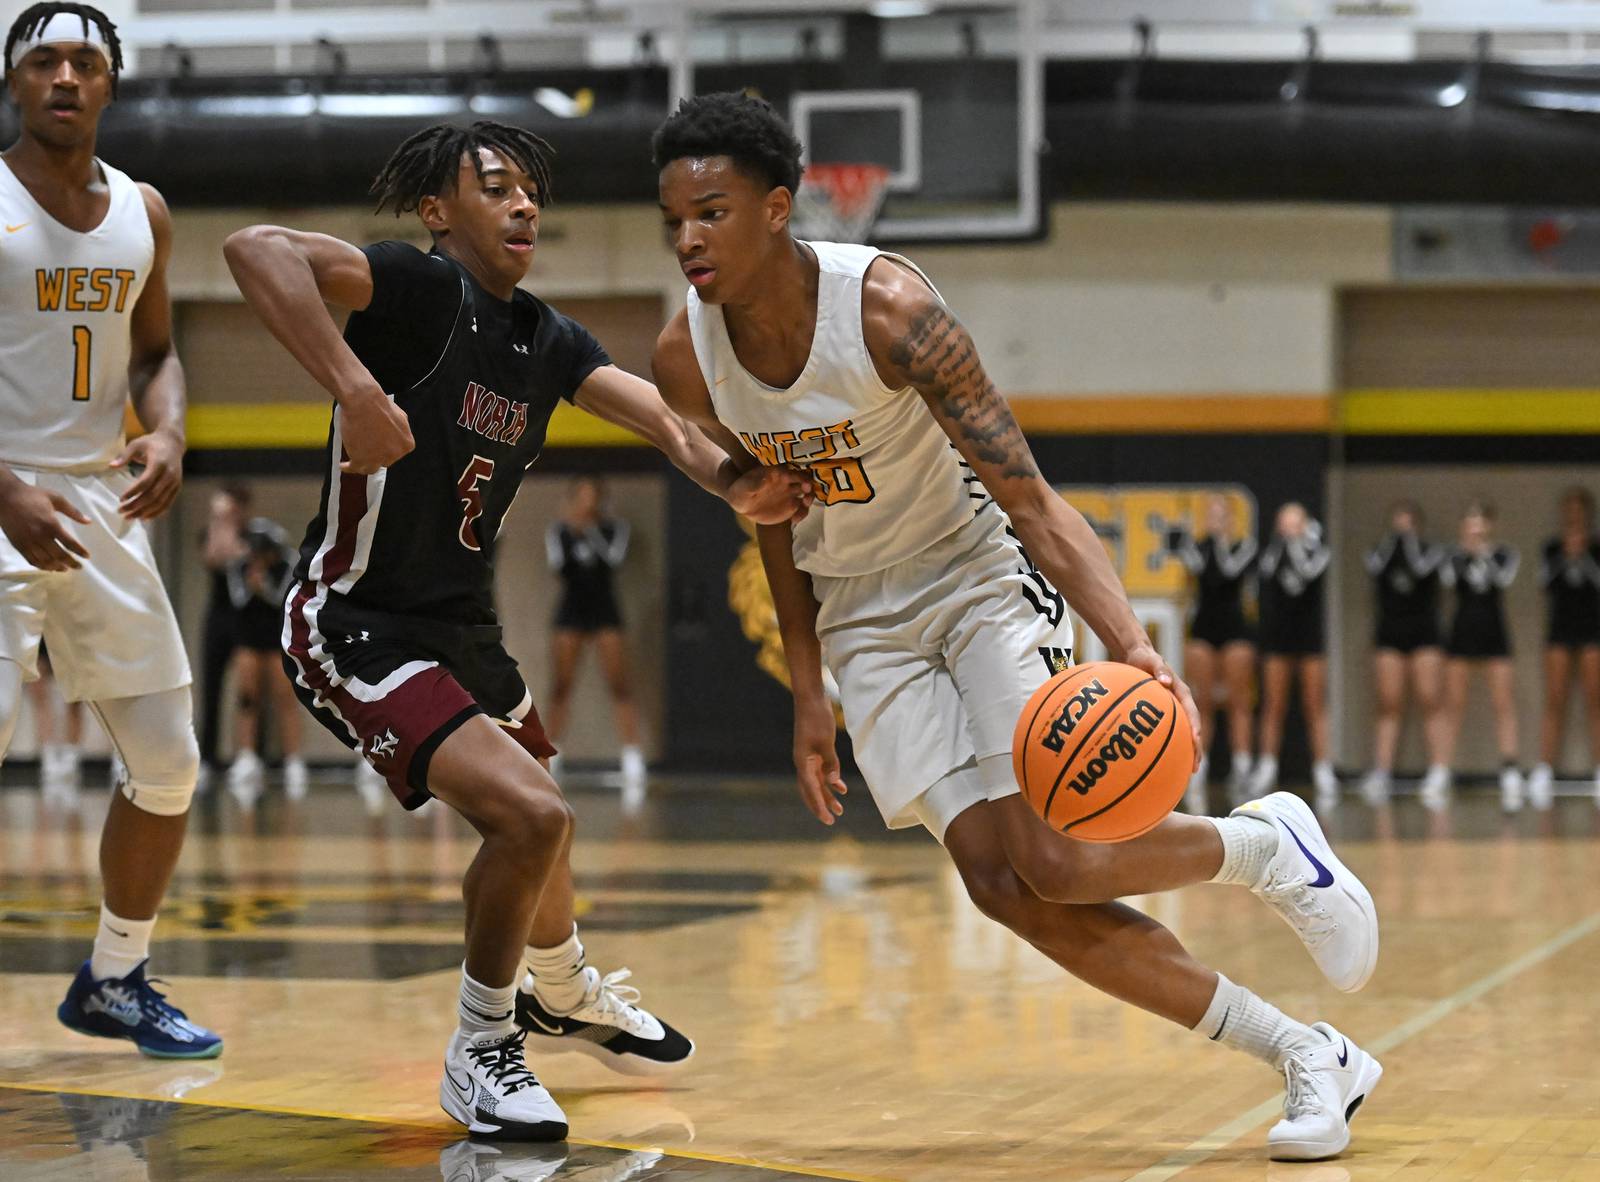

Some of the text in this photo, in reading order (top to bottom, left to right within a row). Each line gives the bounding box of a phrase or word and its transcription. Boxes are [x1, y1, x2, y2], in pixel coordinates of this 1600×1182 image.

[35, 268, 136, 313] WEST
[72, 325, 92, 401] 1
[739, 419, 861, 466] WEST
[456, 454, 495, 552] 5
[1042, 679, 1110, 755] NCAA
[1068, 700, 1165, 796] Wilson
